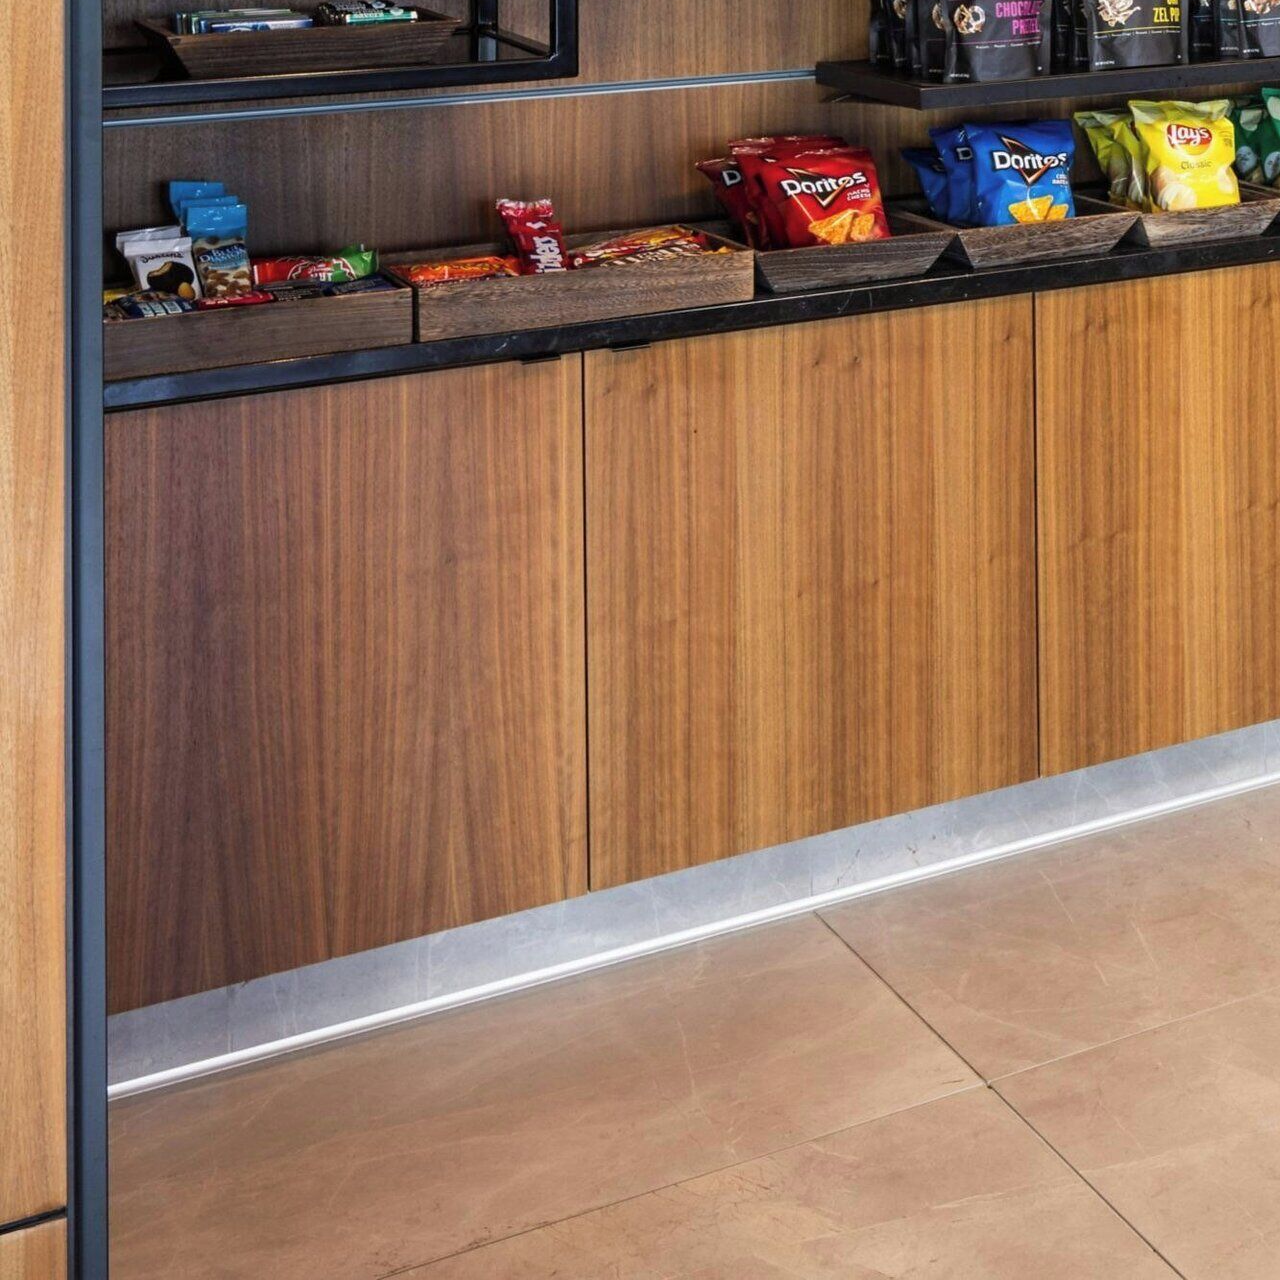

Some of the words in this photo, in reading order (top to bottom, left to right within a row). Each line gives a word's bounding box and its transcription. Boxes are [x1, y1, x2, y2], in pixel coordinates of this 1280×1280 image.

[1167, 123, 1212, 147] Lay's
[992, 149, 1068, 172] Doritos
[1180, 159, 1213, 171] Classic
[780, 170, 868, 198] Doritos
